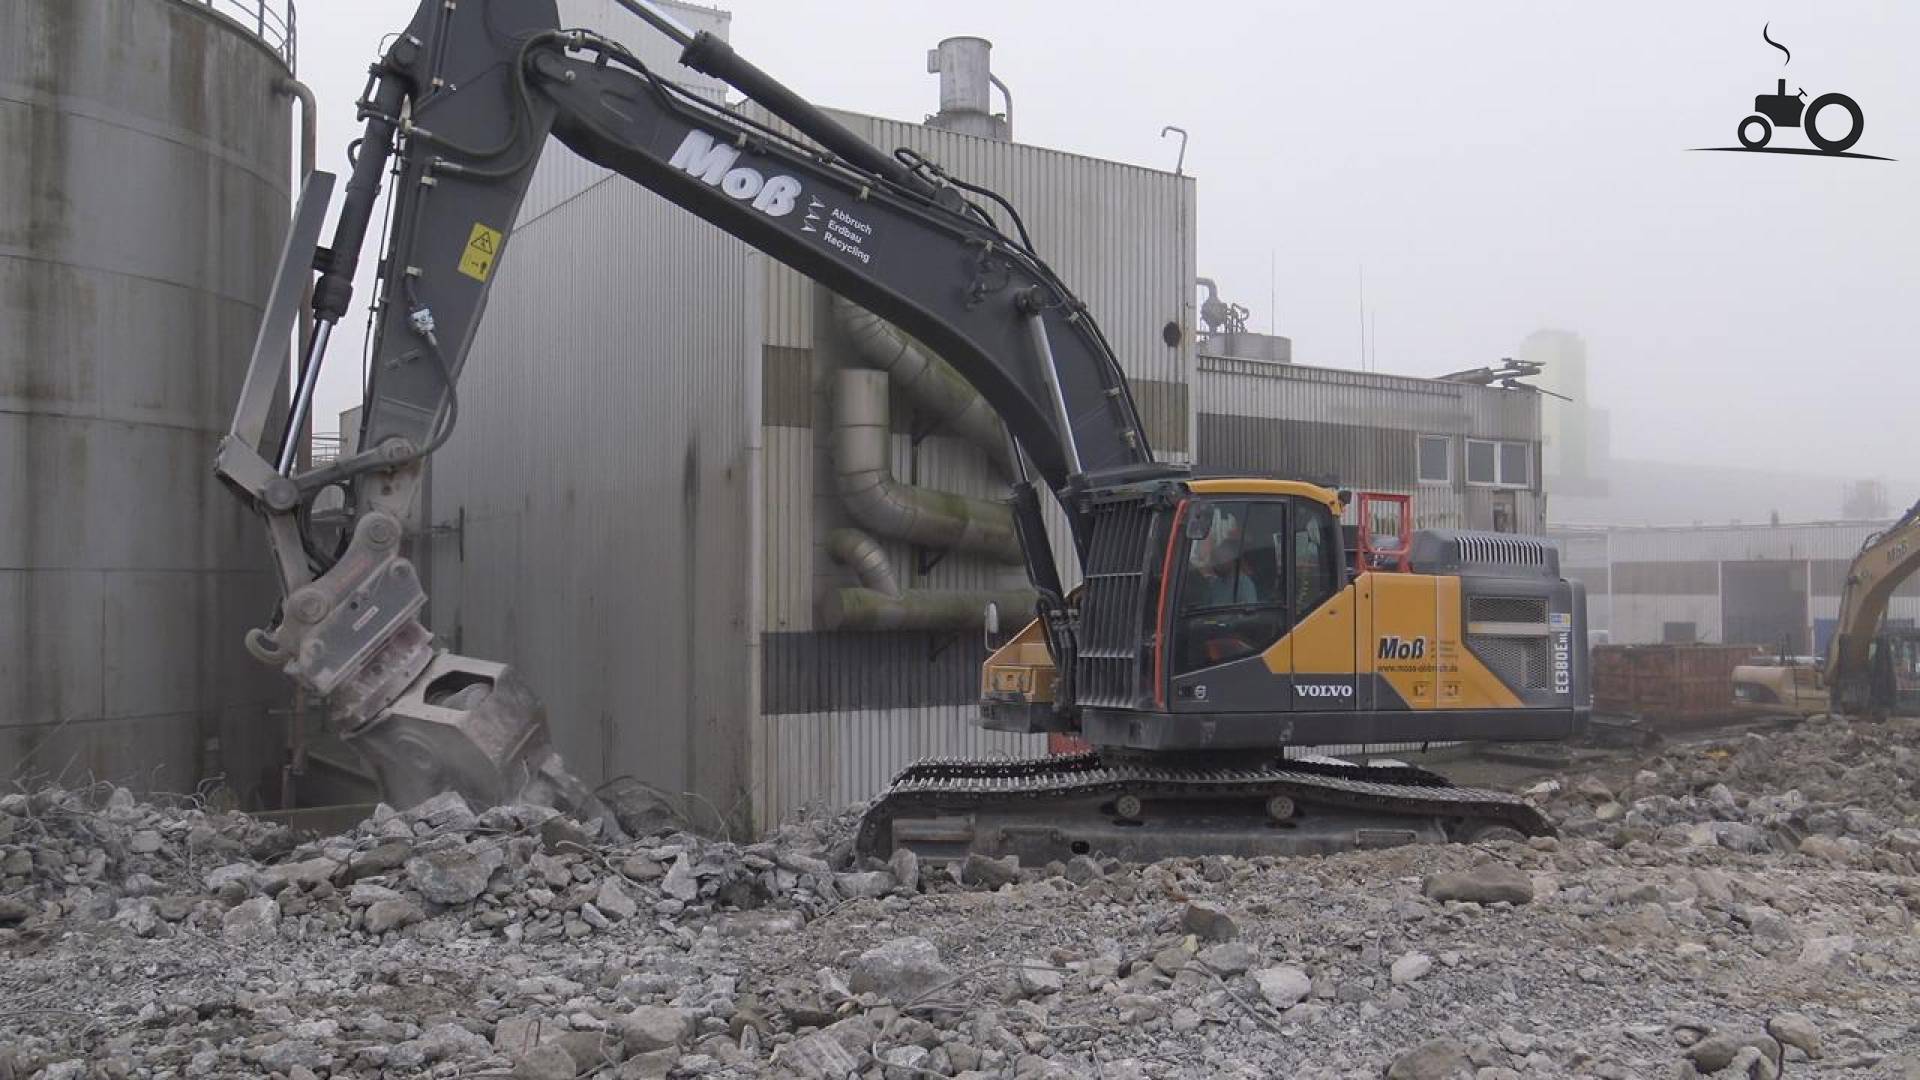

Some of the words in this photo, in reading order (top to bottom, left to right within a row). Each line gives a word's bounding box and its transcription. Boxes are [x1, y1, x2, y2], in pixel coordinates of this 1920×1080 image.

[827, 220, 862, 243] Erdbau
[831, 208, 872, 235] Abbruch
[824, 231, 870, 263] Recycling
[1296, 685, 1352, 697] VOLVO
